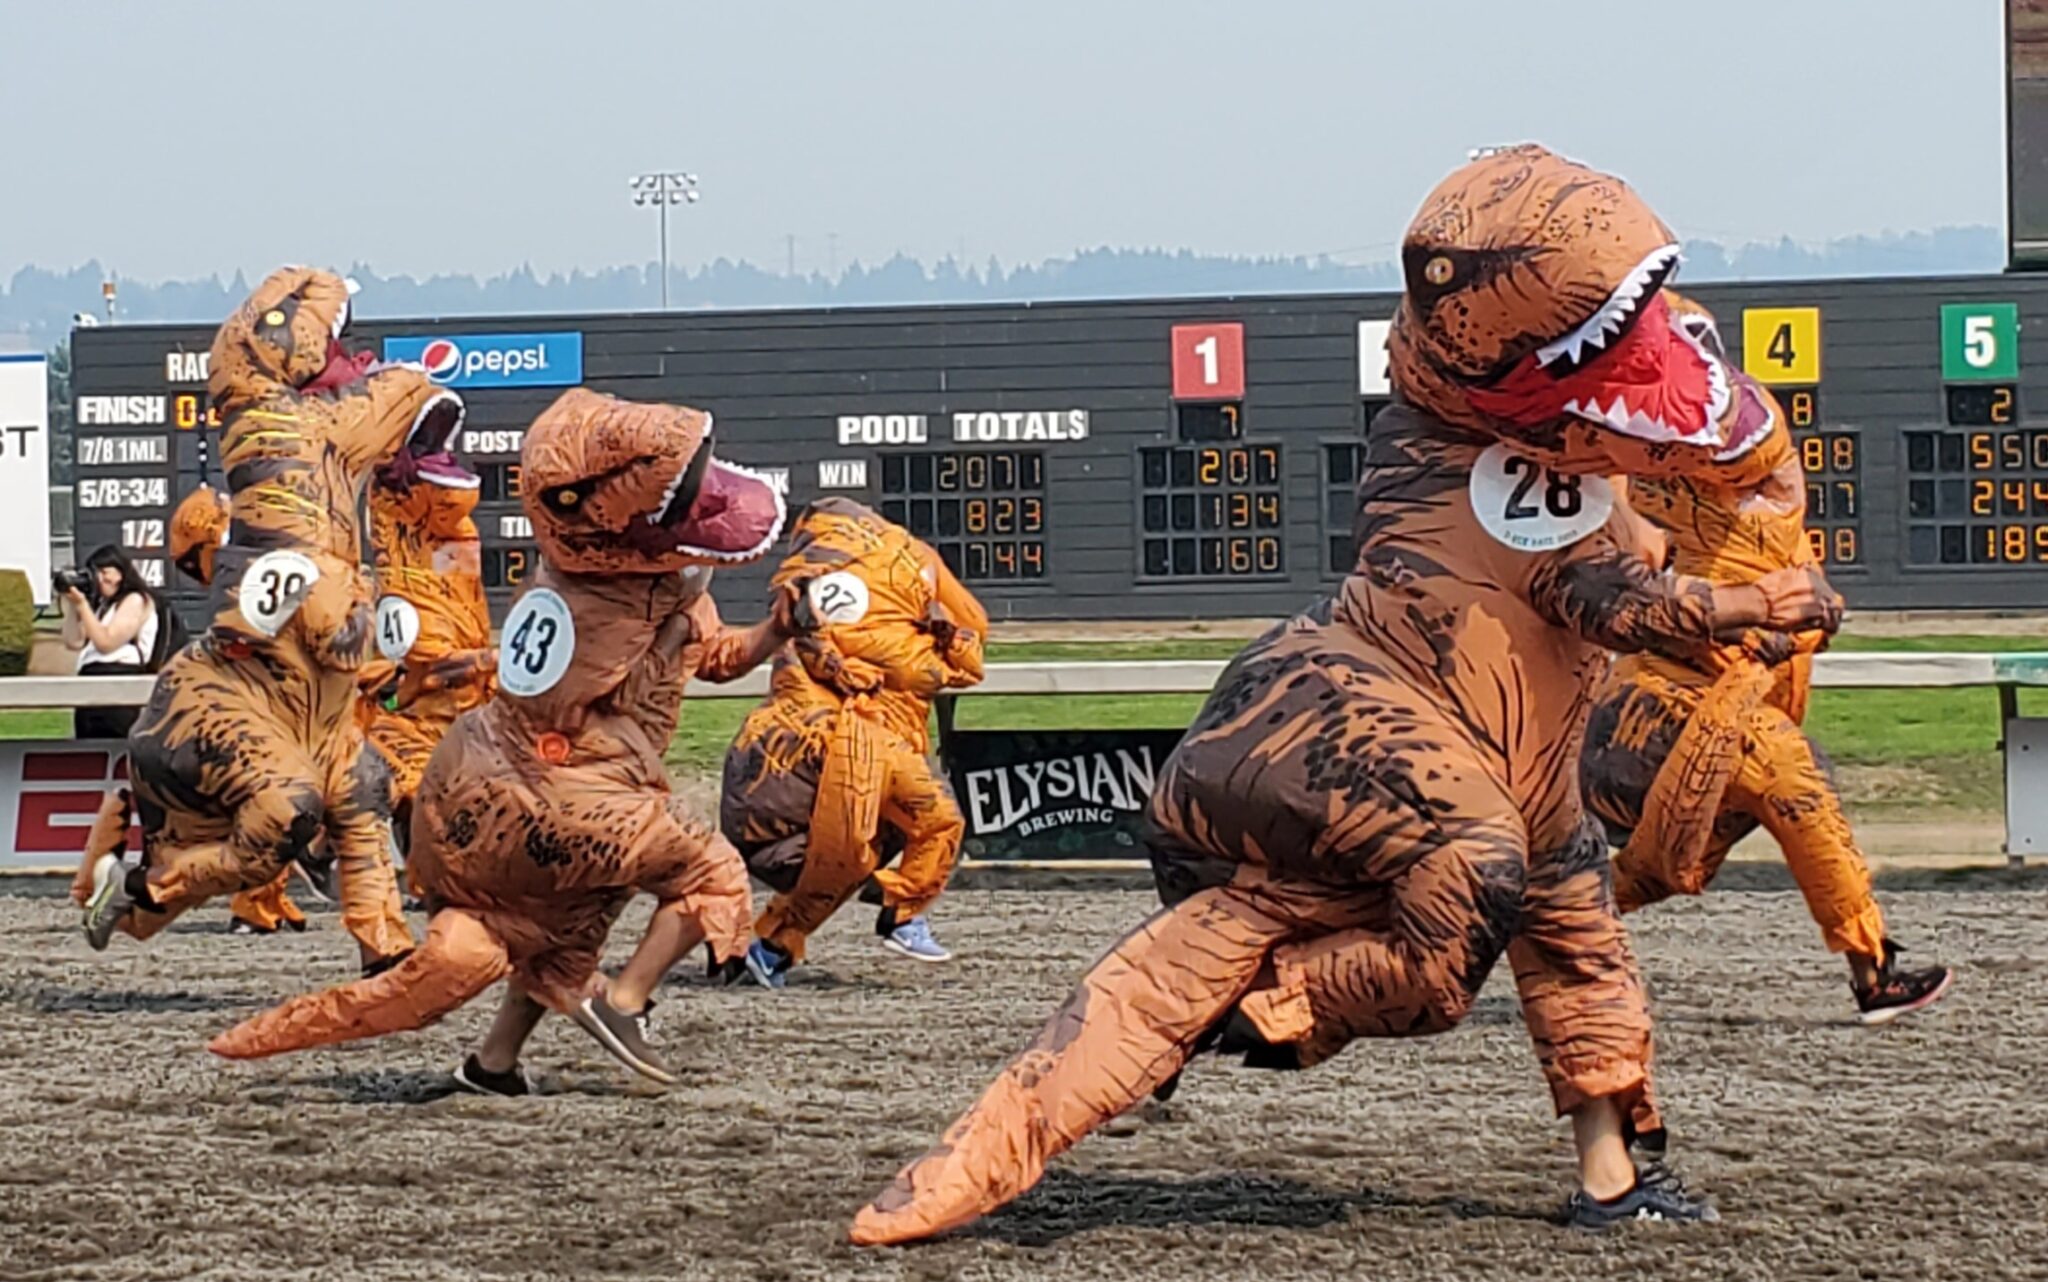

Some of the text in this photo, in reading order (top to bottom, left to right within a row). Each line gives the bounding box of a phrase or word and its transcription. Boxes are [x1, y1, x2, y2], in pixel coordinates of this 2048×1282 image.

[1767, 323, 1795, 368] 4
[1964, 316, 1995, 367] 5
[465, 343, 545, 377] pepsi
[1195, 336, 1219, 385] 1
[79, 396, 166, 424] FINISH
[1220, 406, 1238, 437] 7
[1792, 393, 1812, 425] 8
[1991, 388, 2011, 422] 2
[0, 425, 40, 457] T
[464, 431, 524, 453] POST
[838, 410, 1088, 445] POOL TOTALS
[83, 437, 114, 465] 7/8
[1201, 450, 1276, 485] 207
[819, 460, 867, 489] WIN
[939, 456, 1042, 489] 2071
[1504, 456, 1582, 520] 28
[80, 478, 166, 507] 5/8-3/4
[967, 500, 1041, 533] 823
[1215, 495, 1278, 527] 134
[122, 520, 164, 548] 1/2
[970, 544, 1042, 573] 744
[1216, 538, 1278, 571] 160
[383, 609, 404, 645] 41
[510, 609, 557, 675] 43
[966, 746, 1155, 834] ELYSIAN
[1017, 807, 1114, 837] BREWING
